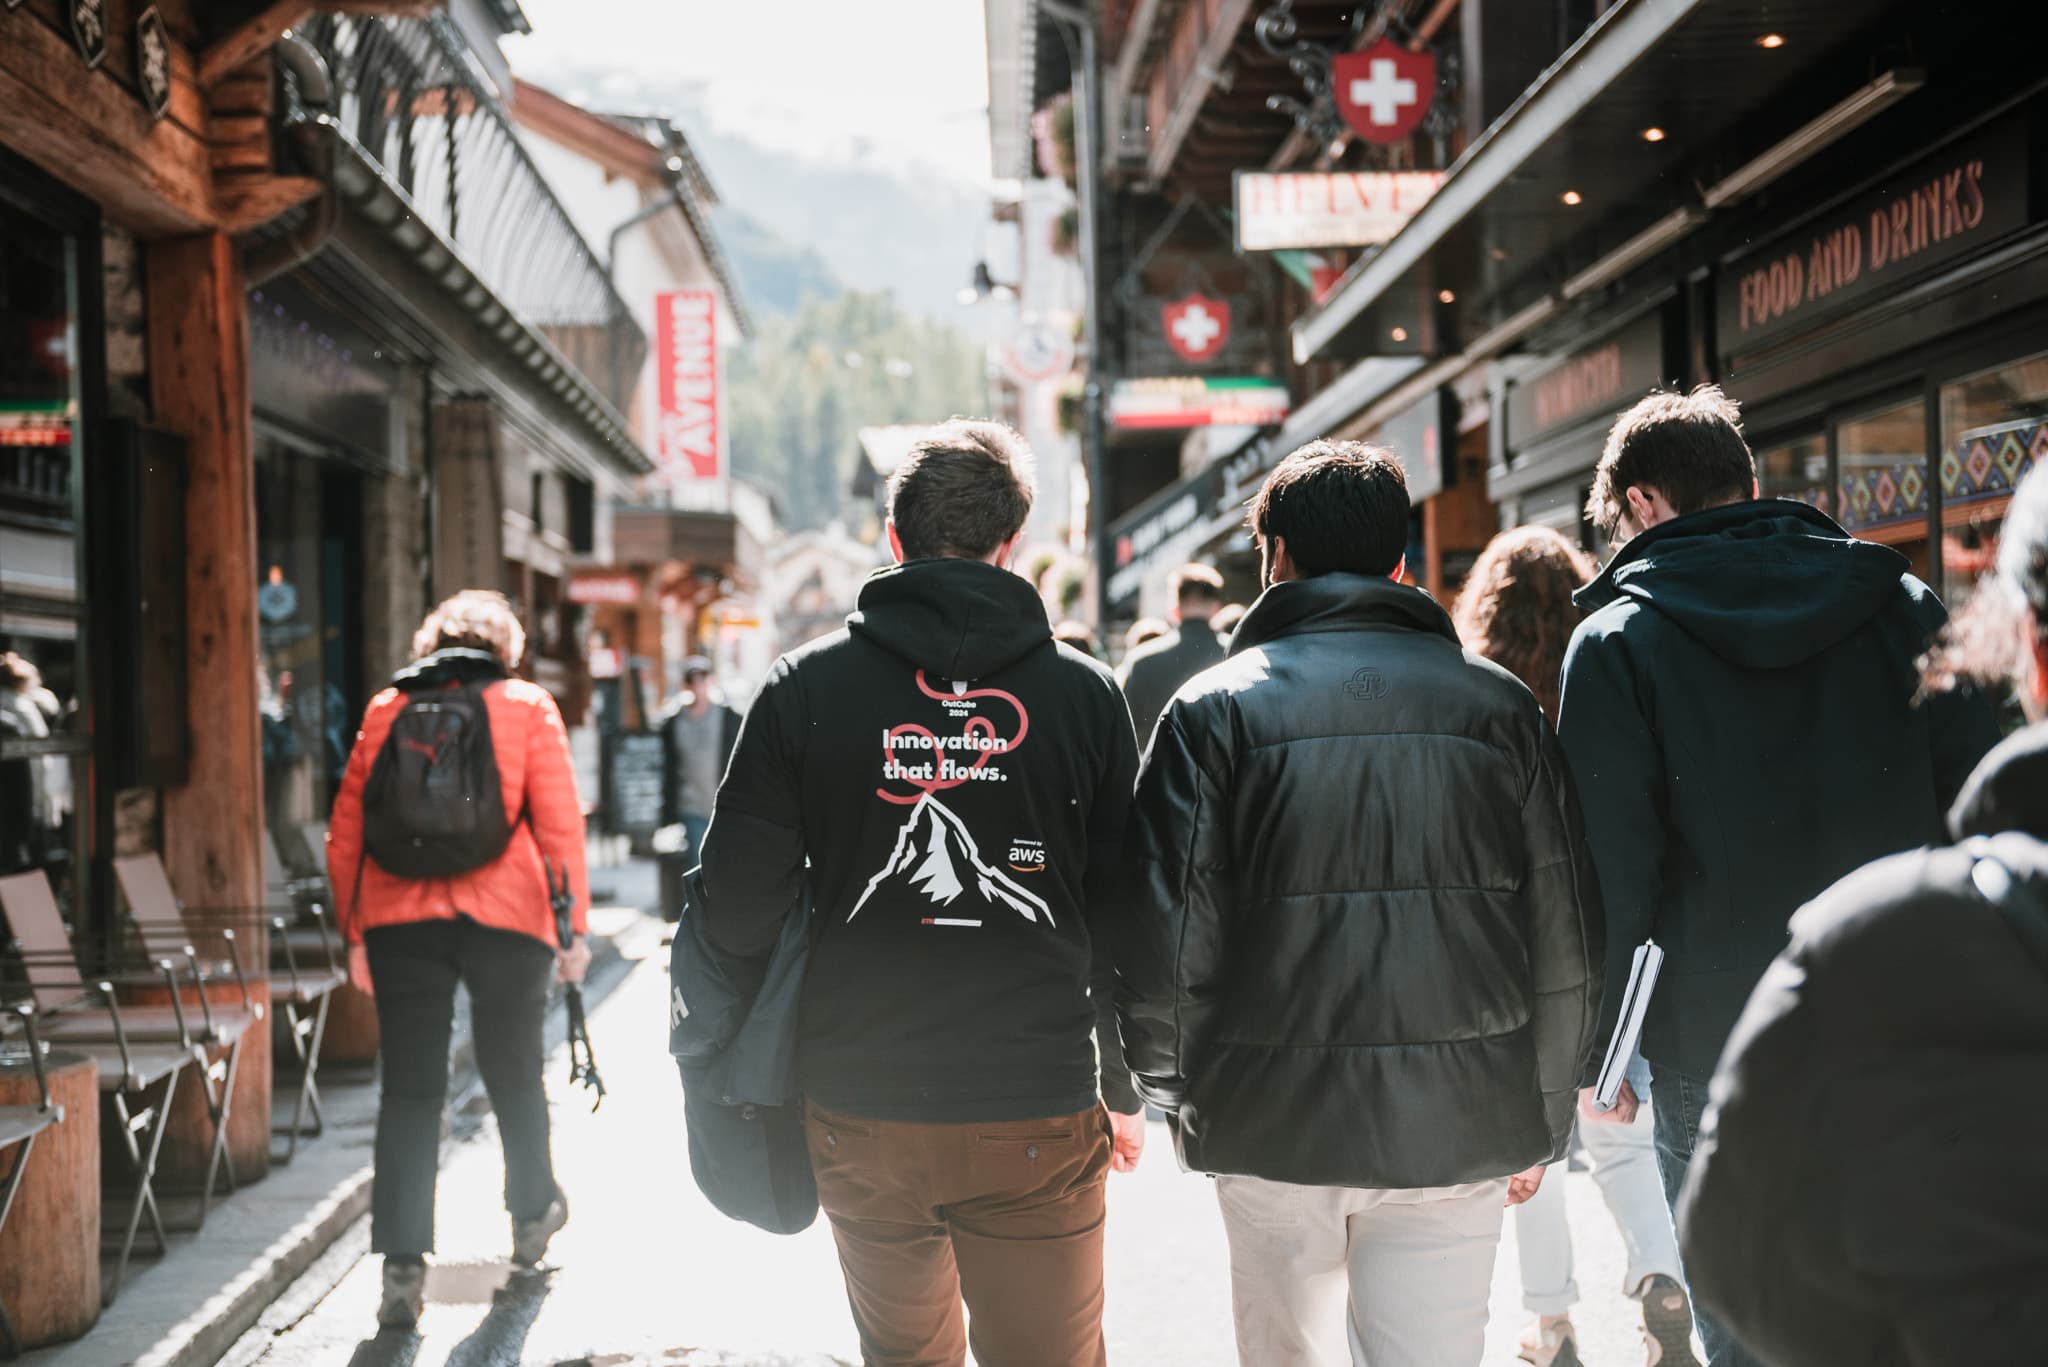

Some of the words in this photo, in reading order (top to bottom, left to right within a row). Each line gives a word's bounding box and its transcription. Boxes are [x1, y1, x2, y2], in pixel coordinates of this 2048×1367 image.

[1739, 254, 1804, 331] FOOD
[1806, 224, 1862, 300] AND
[1869, 160, 1984, 273] DRINKS
[673, 296, 714, 459] AVENUE
[883, 729, 1008, 751] Innovation
[883, 758, 933, 780] that
[939, 758, 1007, 782] flows.
[1008, 847, 1046, 863] aws
